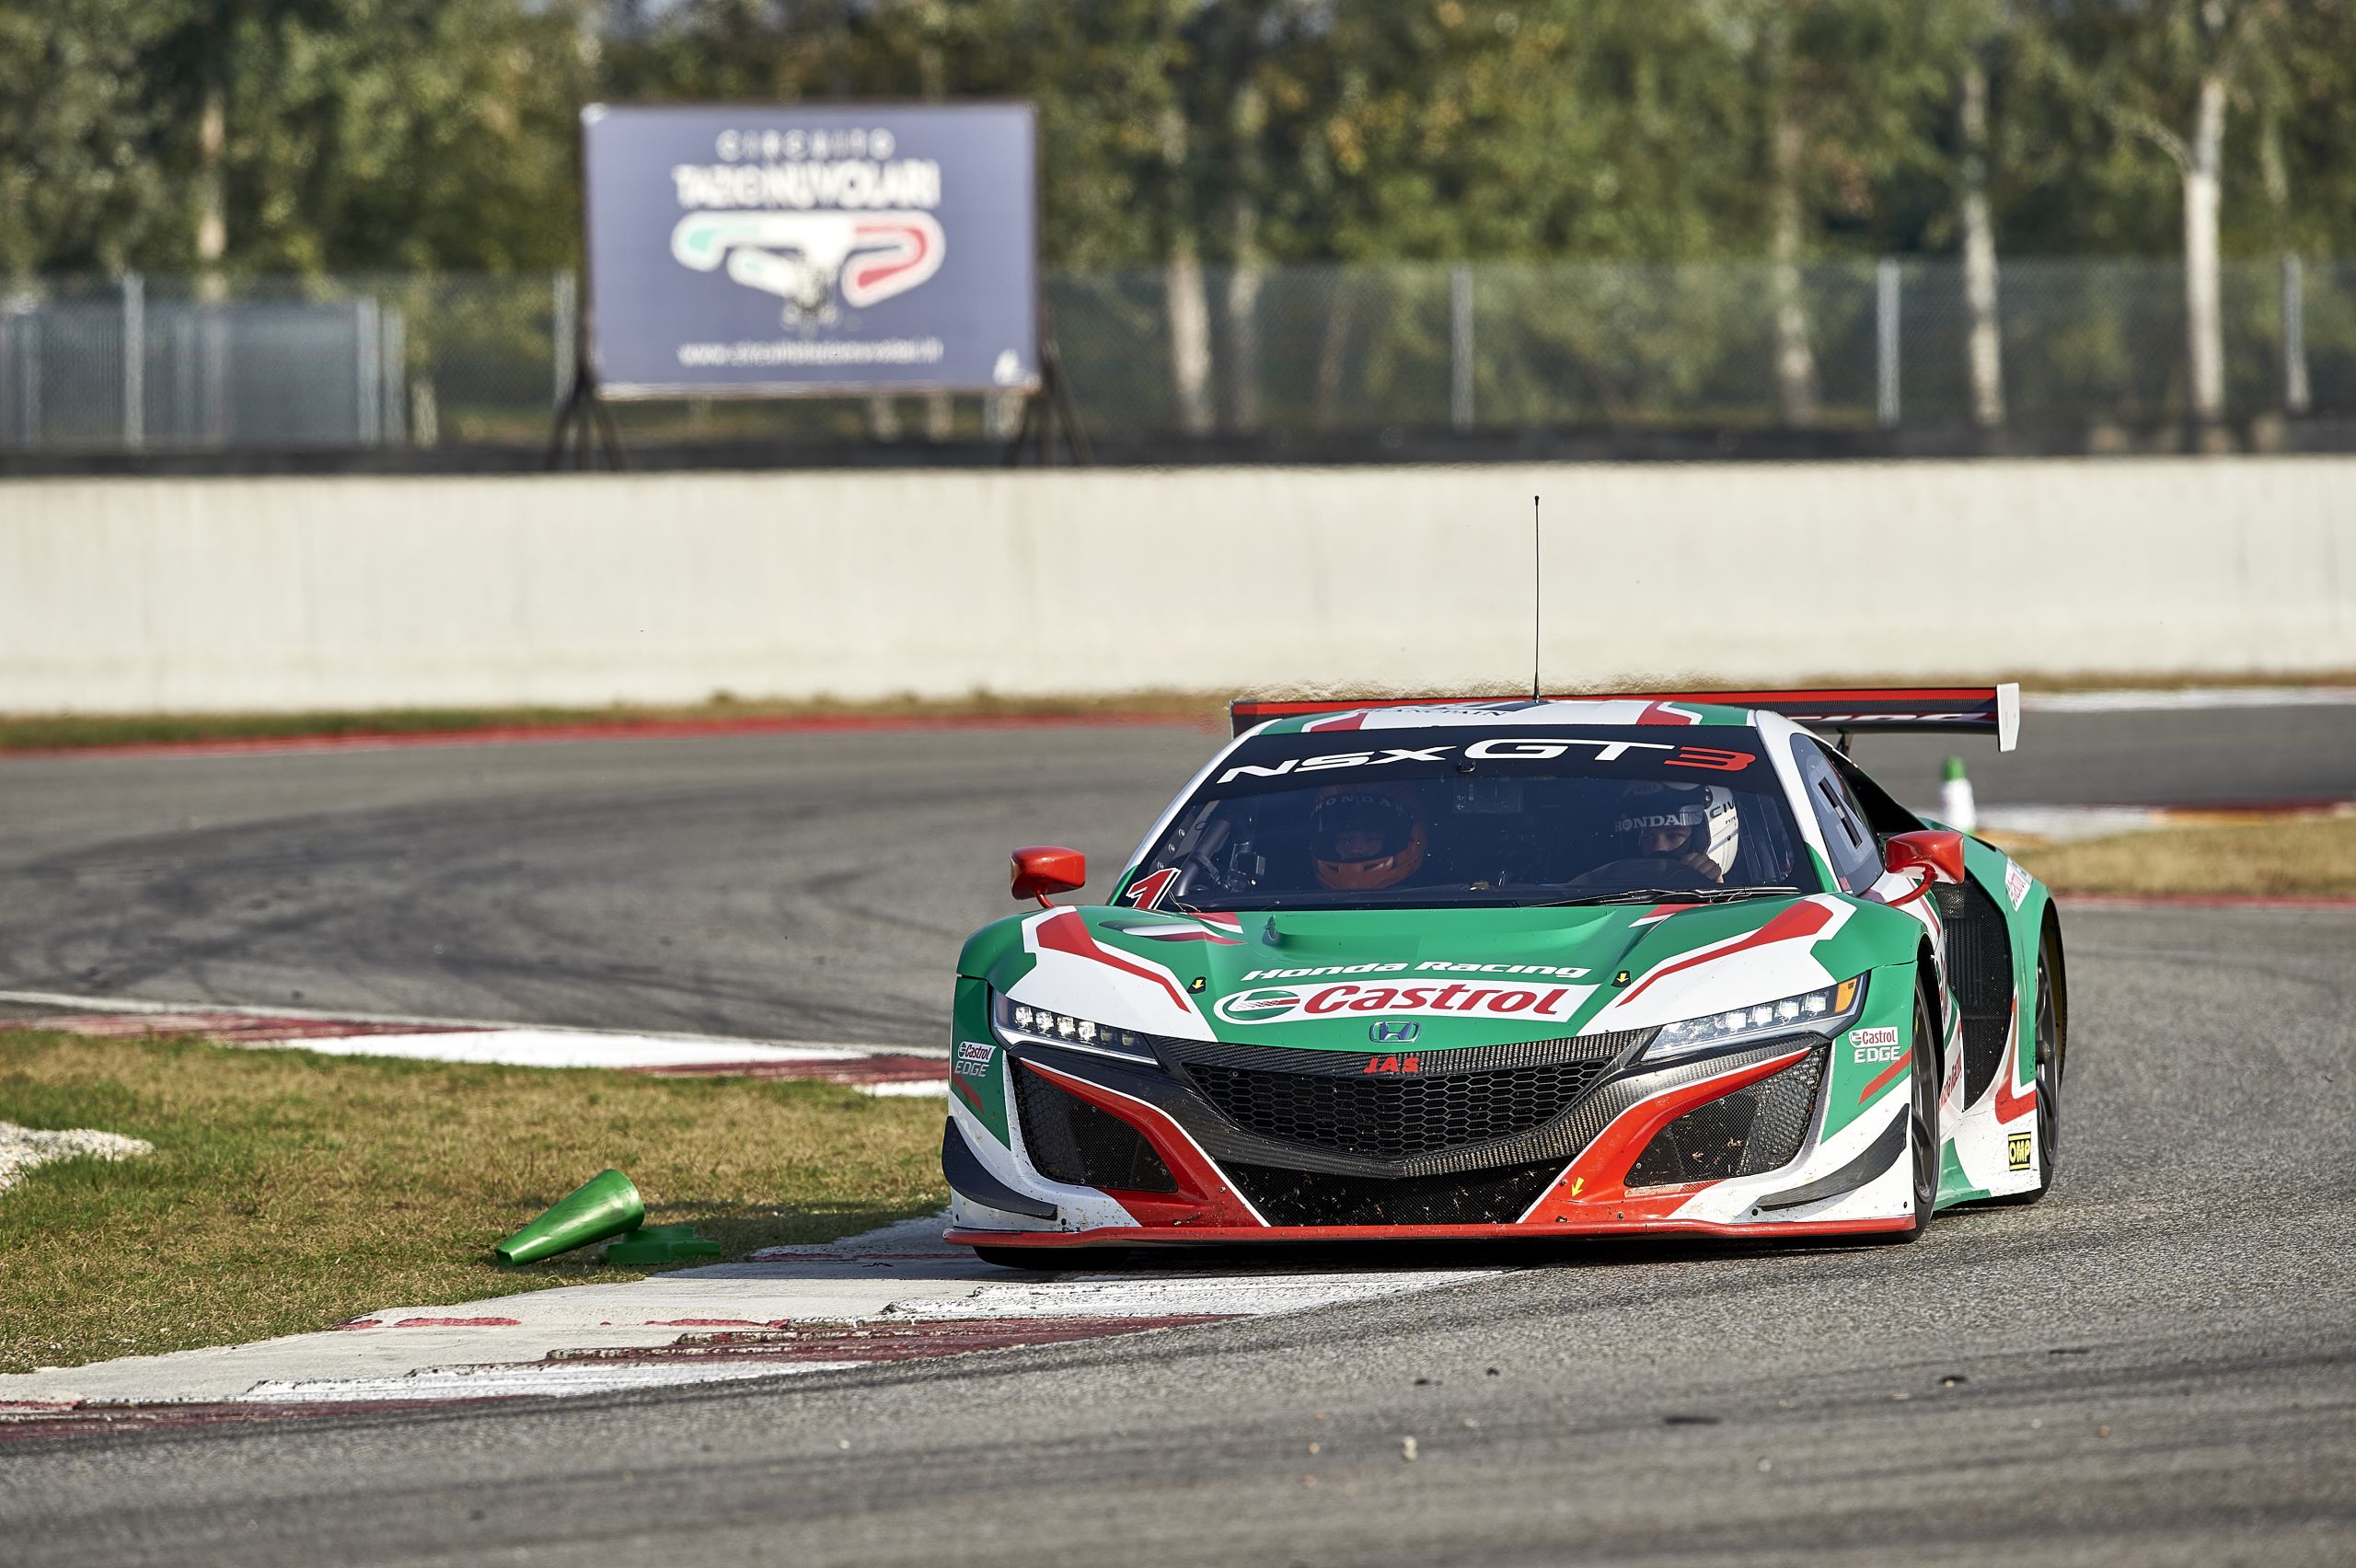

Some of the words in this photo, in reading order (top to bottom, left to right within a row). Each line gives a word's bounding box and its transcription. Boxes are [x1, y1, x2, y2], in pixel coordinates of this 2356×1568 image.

[1216, 746, 1458, 785] NSX
[1614, 814, 1682, 833] HONDA
[1126, 868, 1182, 910] 1
[1240, 962, 1409, 982] Honda
[1414, 960, 1592, 979] Racing
[1303, 983, 1569, 1015] Castrol
[1862, 1030, 1896, 1044] Castrol
[965, 1044, 992, 1060] Castrol
[1854, 1046, 1901, 1064] EDGE
[954, 1060, 989, 1078] EDGE
[1362, 1055, 1421, 1075] JAS
[2009, 1139, 2030, 1163] OMP
